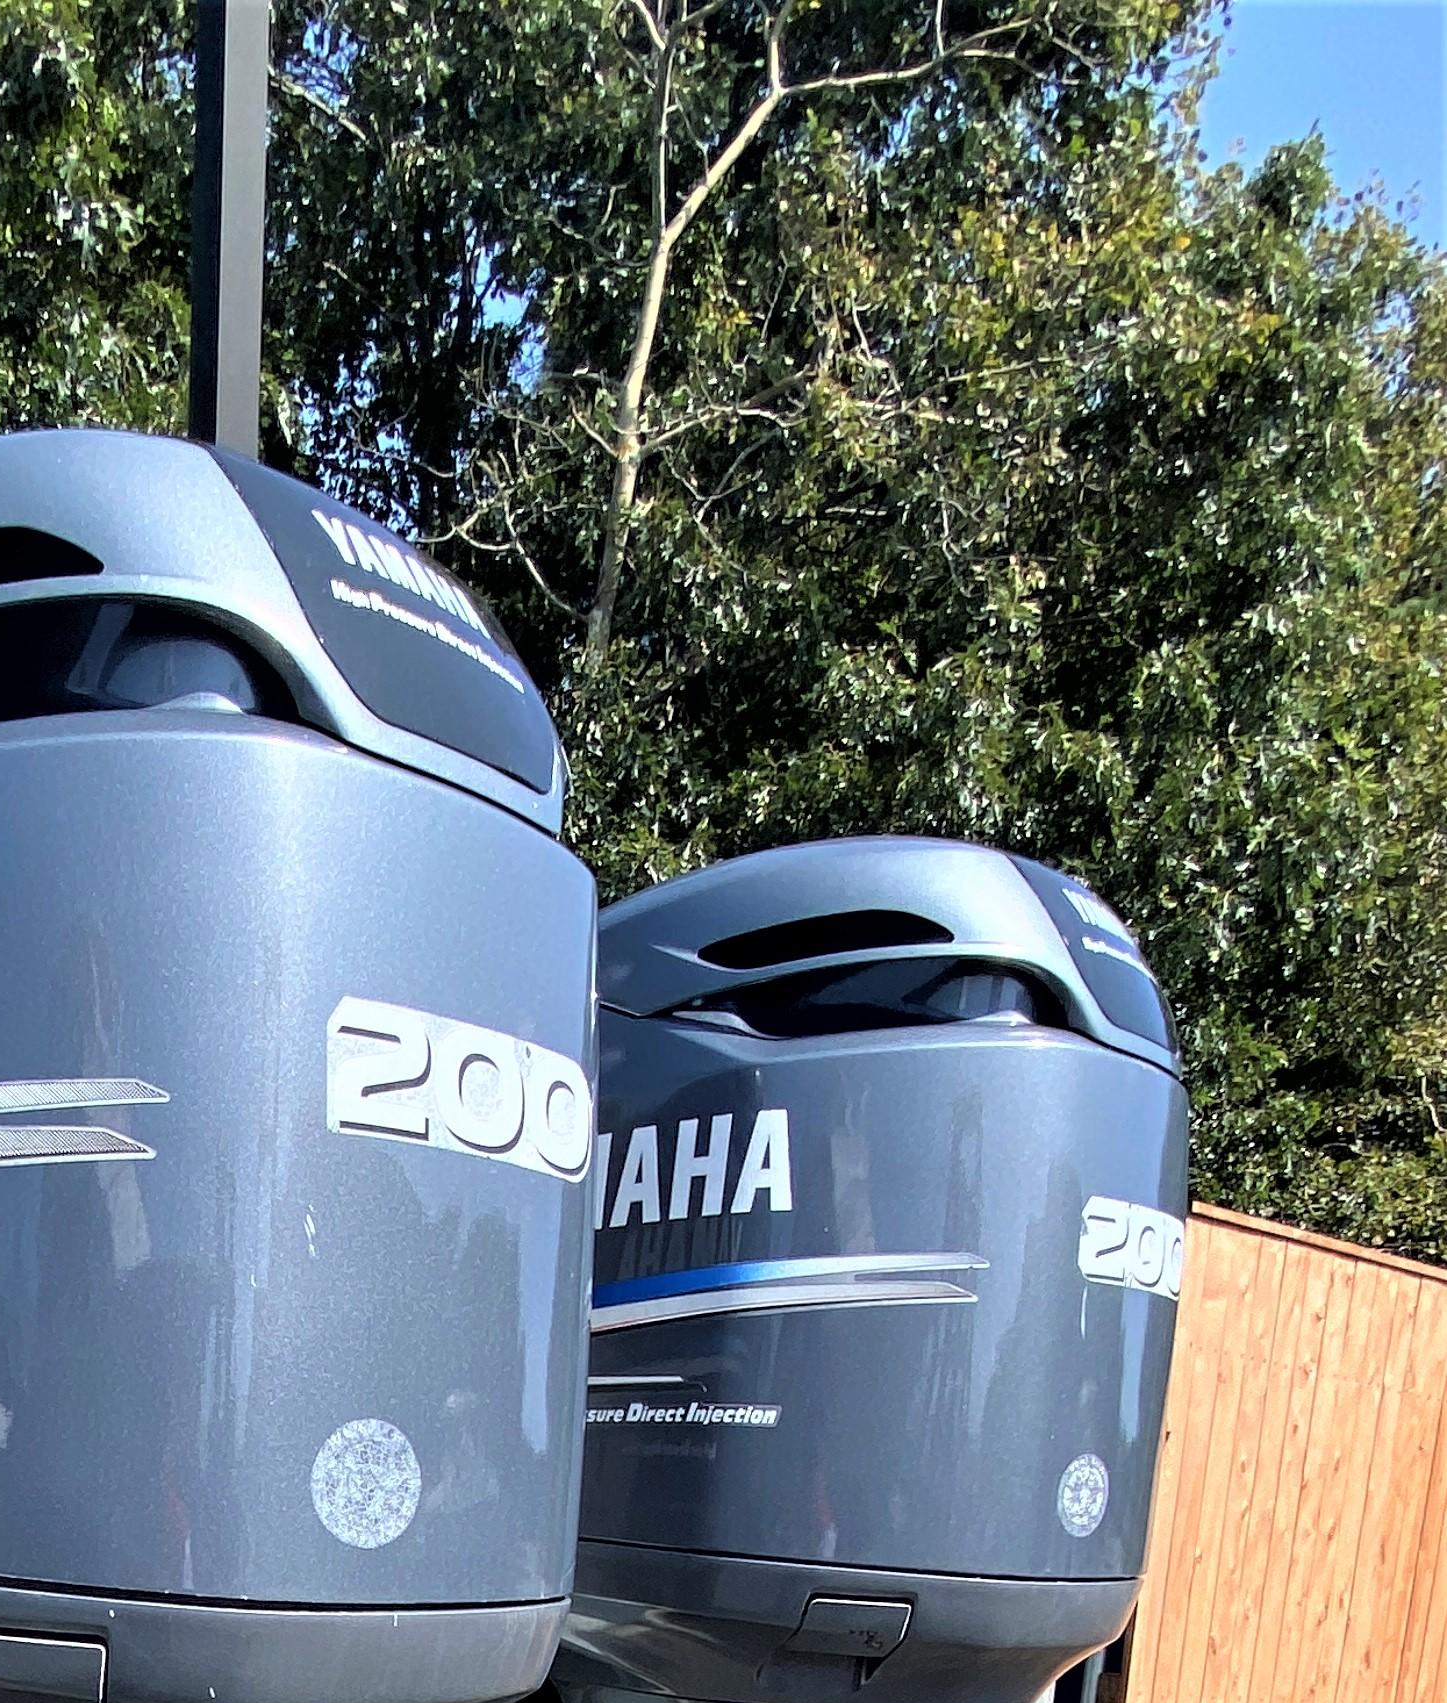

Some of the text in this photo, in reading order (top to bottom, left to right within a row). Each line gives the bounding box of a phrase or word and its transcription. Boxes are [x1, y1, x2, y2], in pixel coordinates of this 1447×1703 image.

[327, 996, 594, 1184] 200
[594, 1108, 793, 1230] AHA
[586, 1401, 779, 1426] sure Direct Injection
